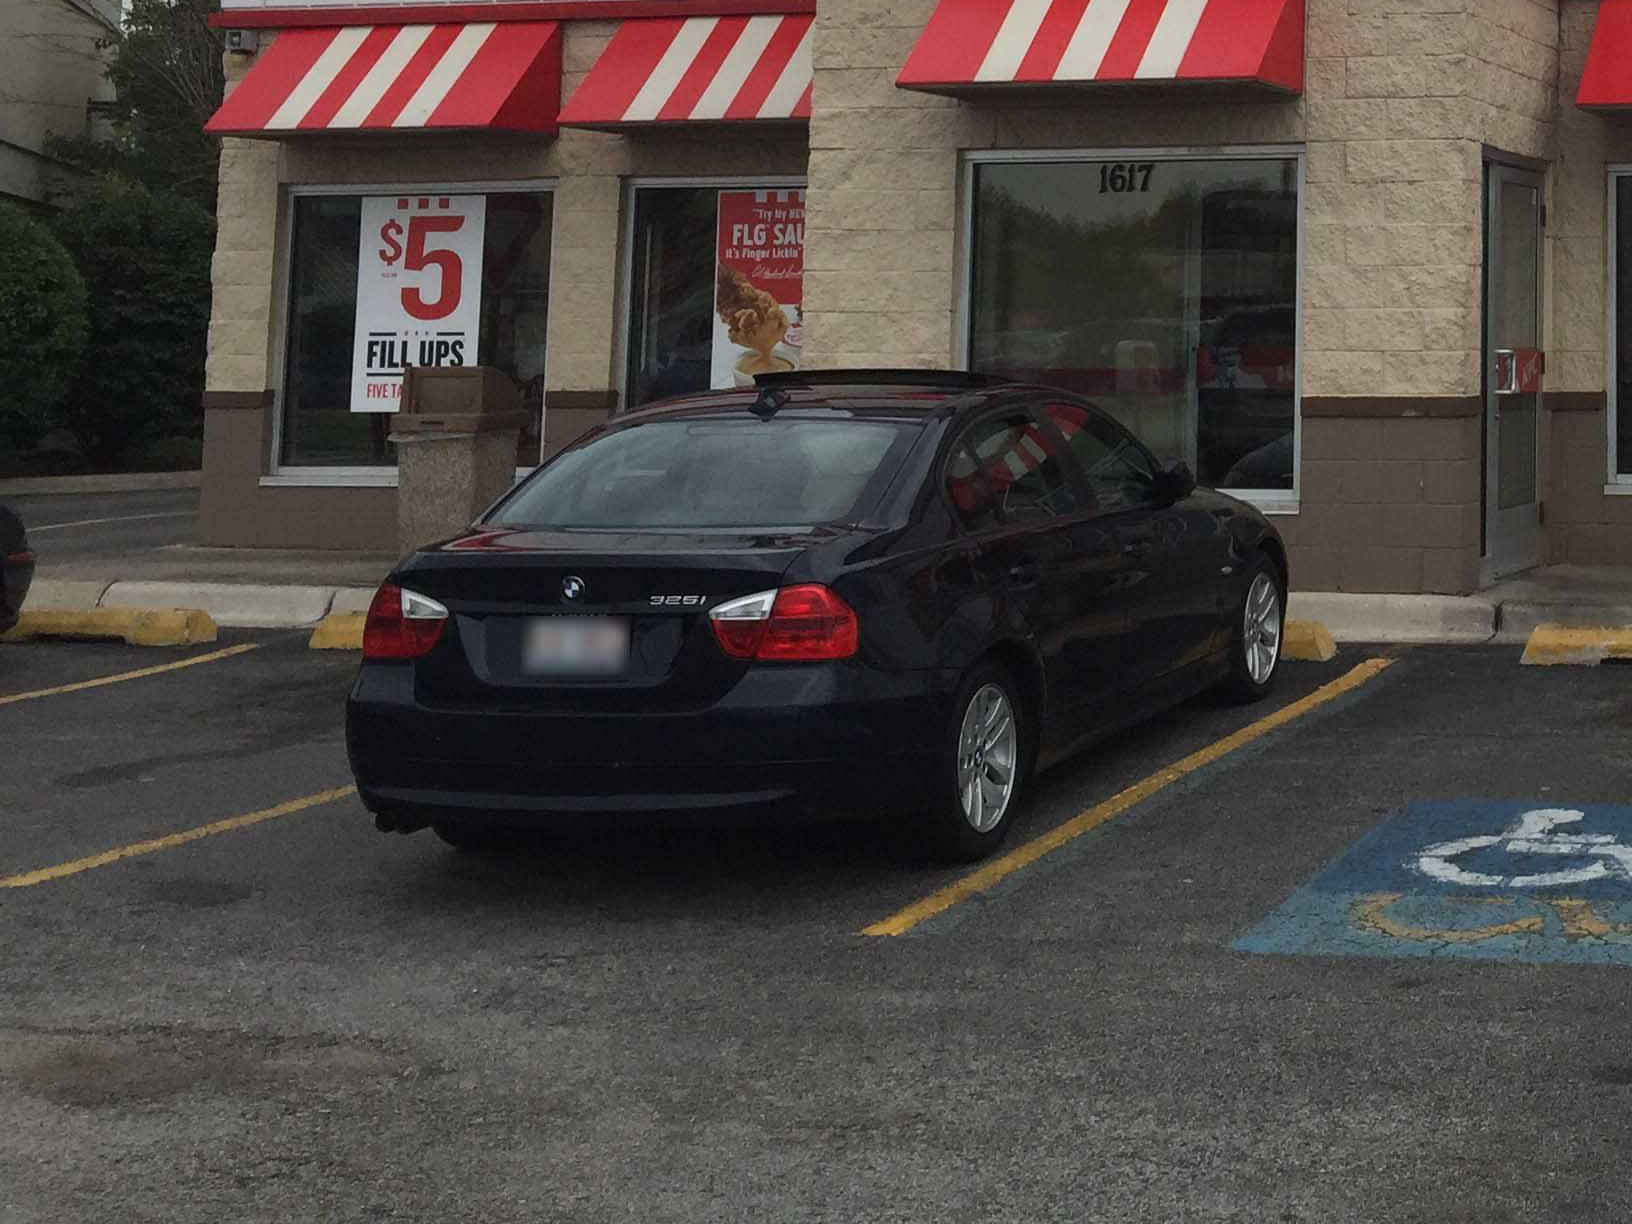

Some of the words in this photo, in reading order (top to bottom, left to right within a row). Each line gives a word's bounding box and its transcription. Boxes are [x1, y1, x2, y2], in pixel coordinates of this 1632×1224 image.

[1098, 163, 1155, 193] 1617
[732, 223, 767, 246] FLG
[742, 248, 769, 261] Finger
[378, 215, 465, 321] $5
[366, 340, 412, 368] FILL
[419, 340, 465, 367] UPS
[367, 383, 389, 399] FIVE
